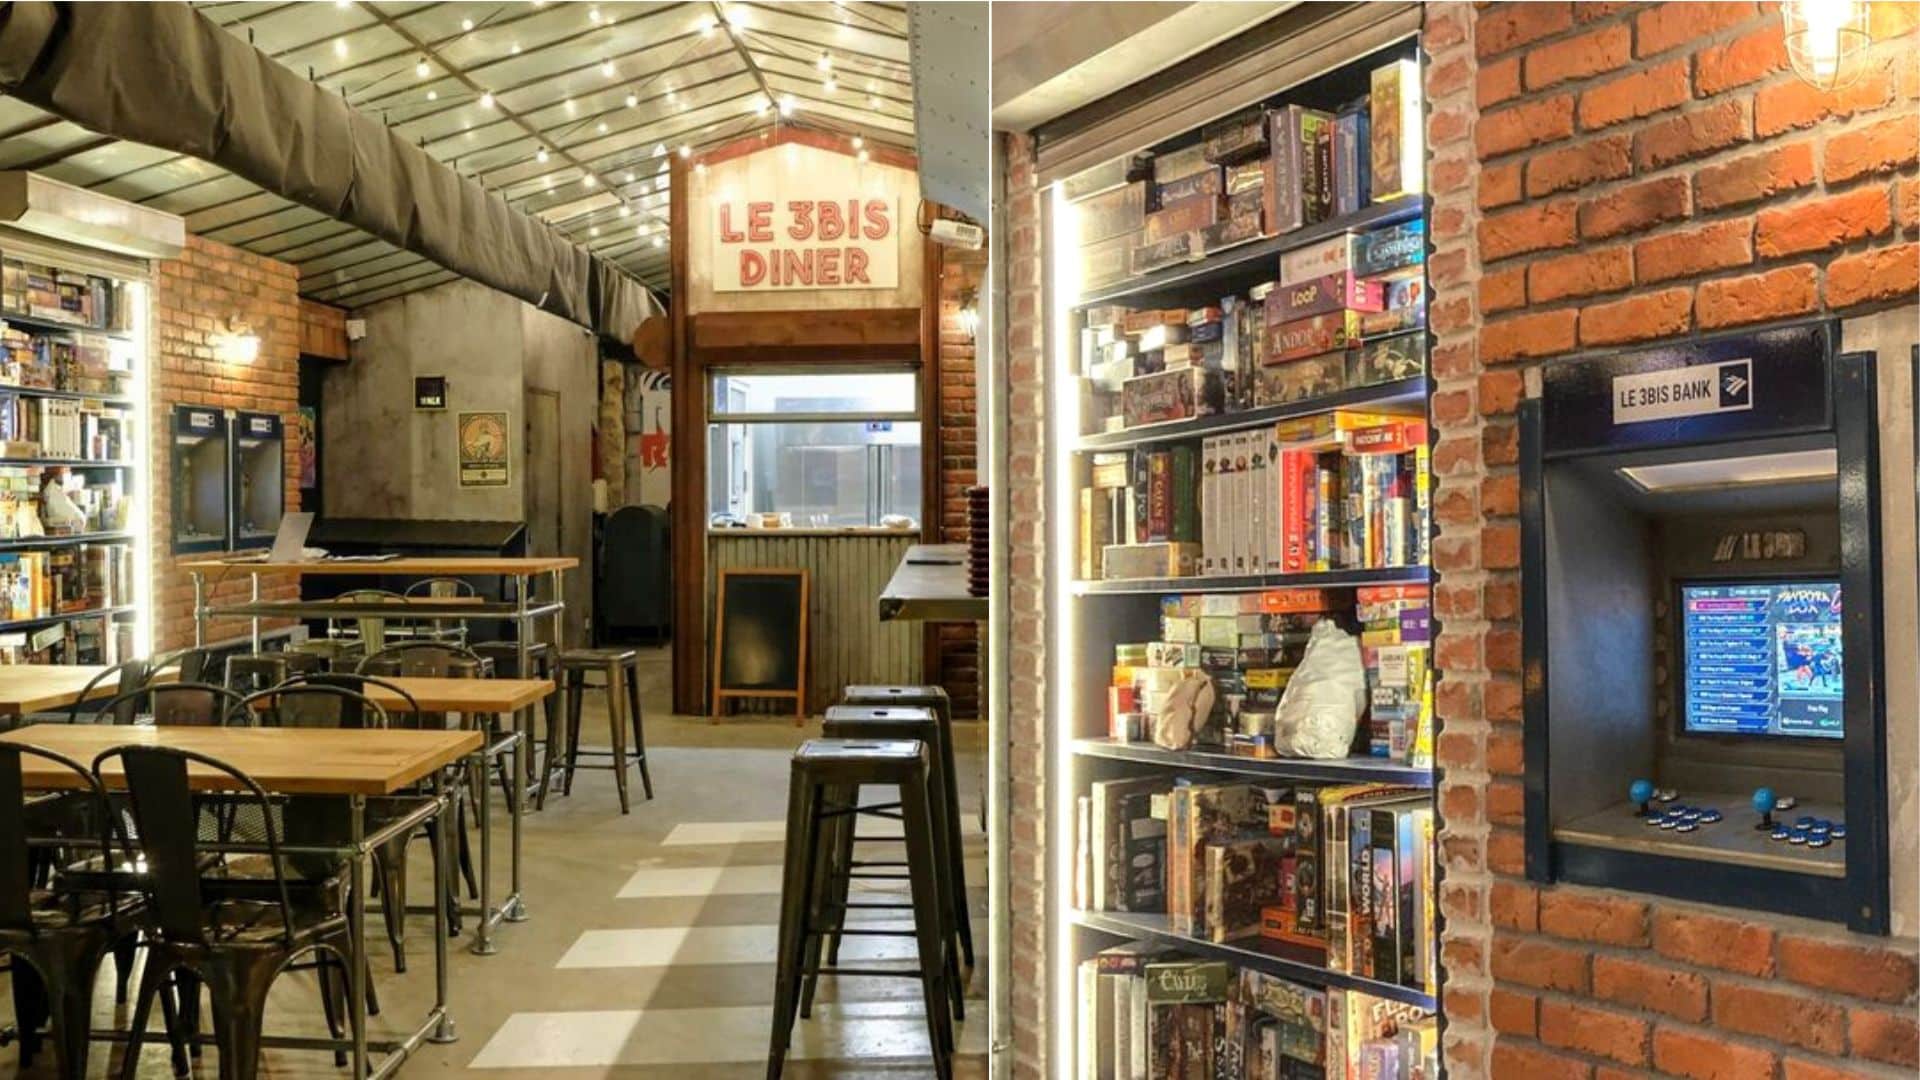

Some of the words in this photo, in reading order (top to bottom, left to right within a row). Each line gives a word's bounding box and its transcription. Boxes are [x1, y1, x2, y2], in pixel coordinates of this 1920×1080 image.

[720, 202, 774, 243] LE
[787, 199, 890, 241] 3BIS
[739, 247, 870, 287] DINER
[1620, 389, 1637, 408] LE
[1639, 385, 1669, 406] 3BIS
[1673, 379, 1712, 402] BANK
[1361, 849, 1371, 915] WORLD
